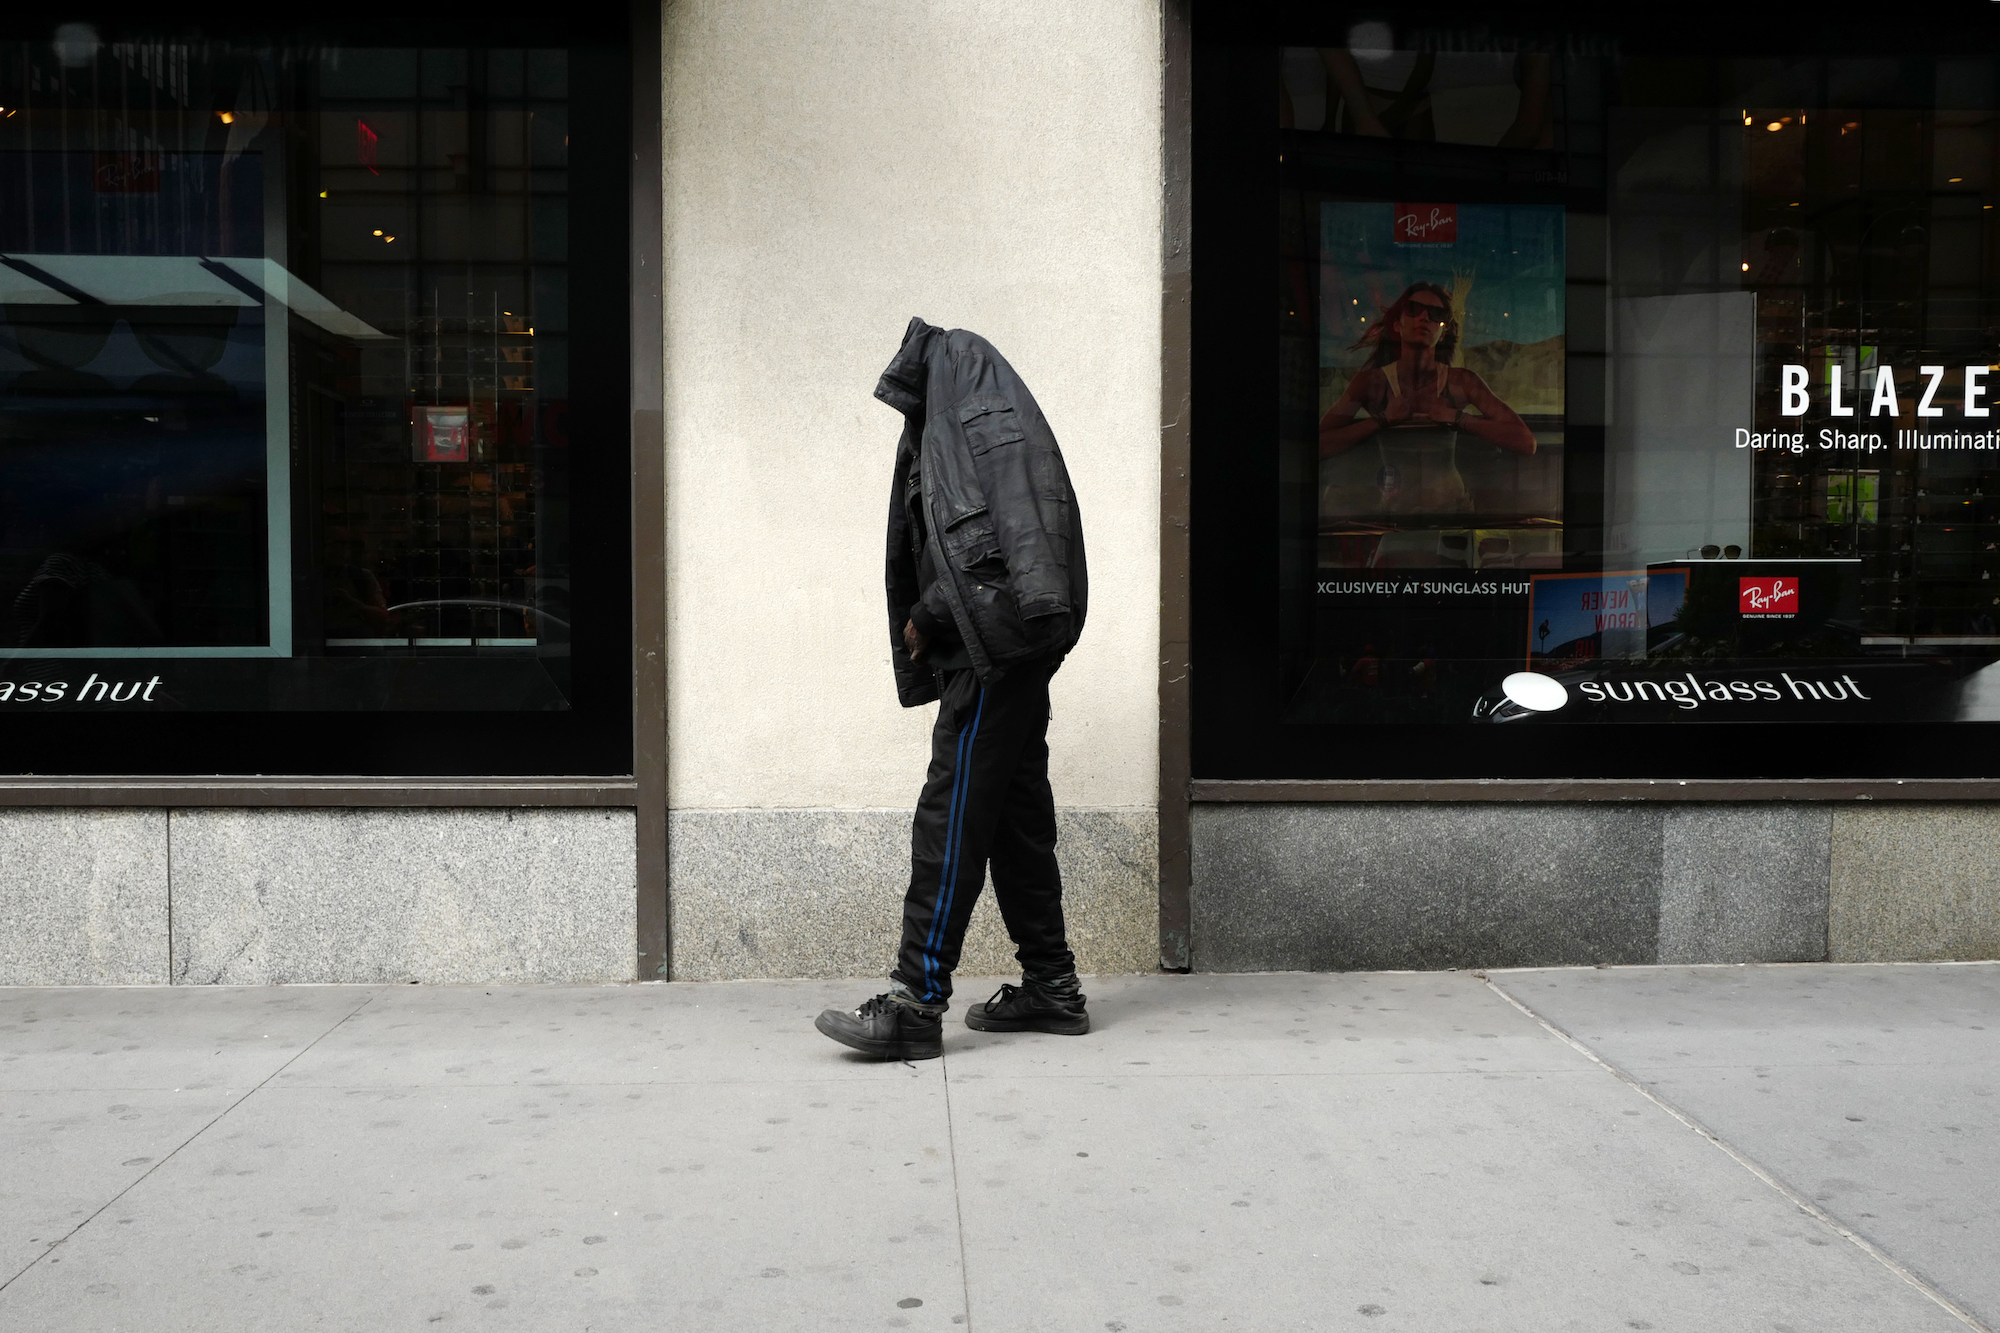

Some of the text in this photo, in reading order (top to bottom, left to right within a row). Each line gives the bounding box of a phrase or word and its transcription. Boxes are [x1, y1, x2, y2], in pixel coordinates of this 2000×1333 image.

[1398, 208, 1453, 238] Ray-Ban
[1781, 364, 1990, 417] BLAZE
[1735, 428, 1810, 453] Daring.
[1819, 429, 1888, 454] Sharp.
[1317, 582, 1531, 595] XCLUSIVELY AT SUNGLASS HUT
[1742, 580, 1795, 609] Ray-Ban
[75, 672, 164, 703] hut
[1579, 672, 1871, 710] sunglass hut
